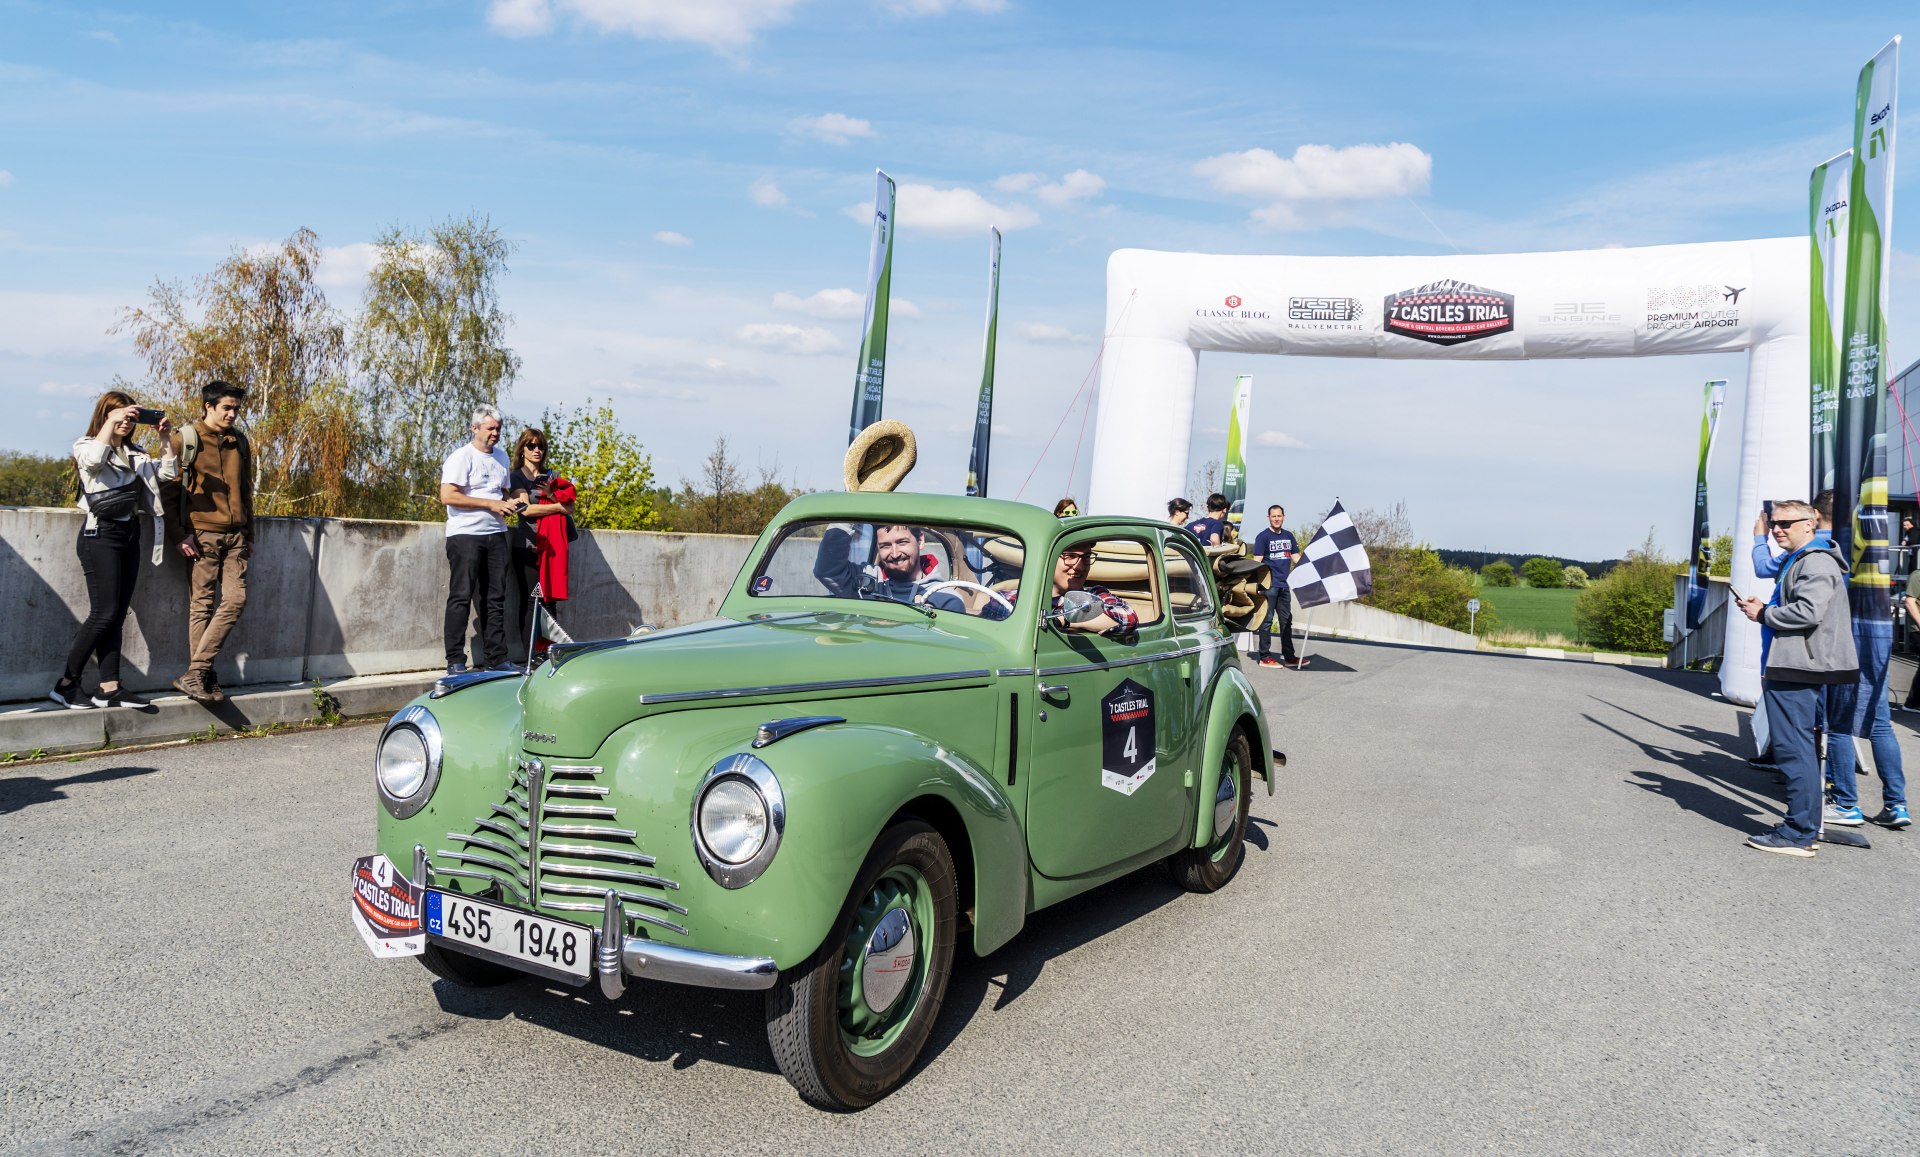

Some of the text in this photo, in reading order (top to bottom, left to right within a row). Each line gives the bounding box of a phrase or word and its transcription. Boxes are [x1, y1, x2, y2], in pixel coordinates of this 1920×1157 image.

[1196, 309, 1270, 319] CLASSIC BLOG
[1390, 305, 1508, 322] 7 CASTLES TRIAL
[1693, 319, 1739, 329] AIRPORT
[1109, 698, 1149, 714] 7 CASTLES TRIAL
[1123, 726, 1138, 764] 4
[378, 862, 385, 883] 4
[359, 879, 389, 911] CASTLES
[390, 895, 419, 918] TRIAL
[429, 918, 441, 930] CZ
[448, 902, 577, 966] 4S5 1948
